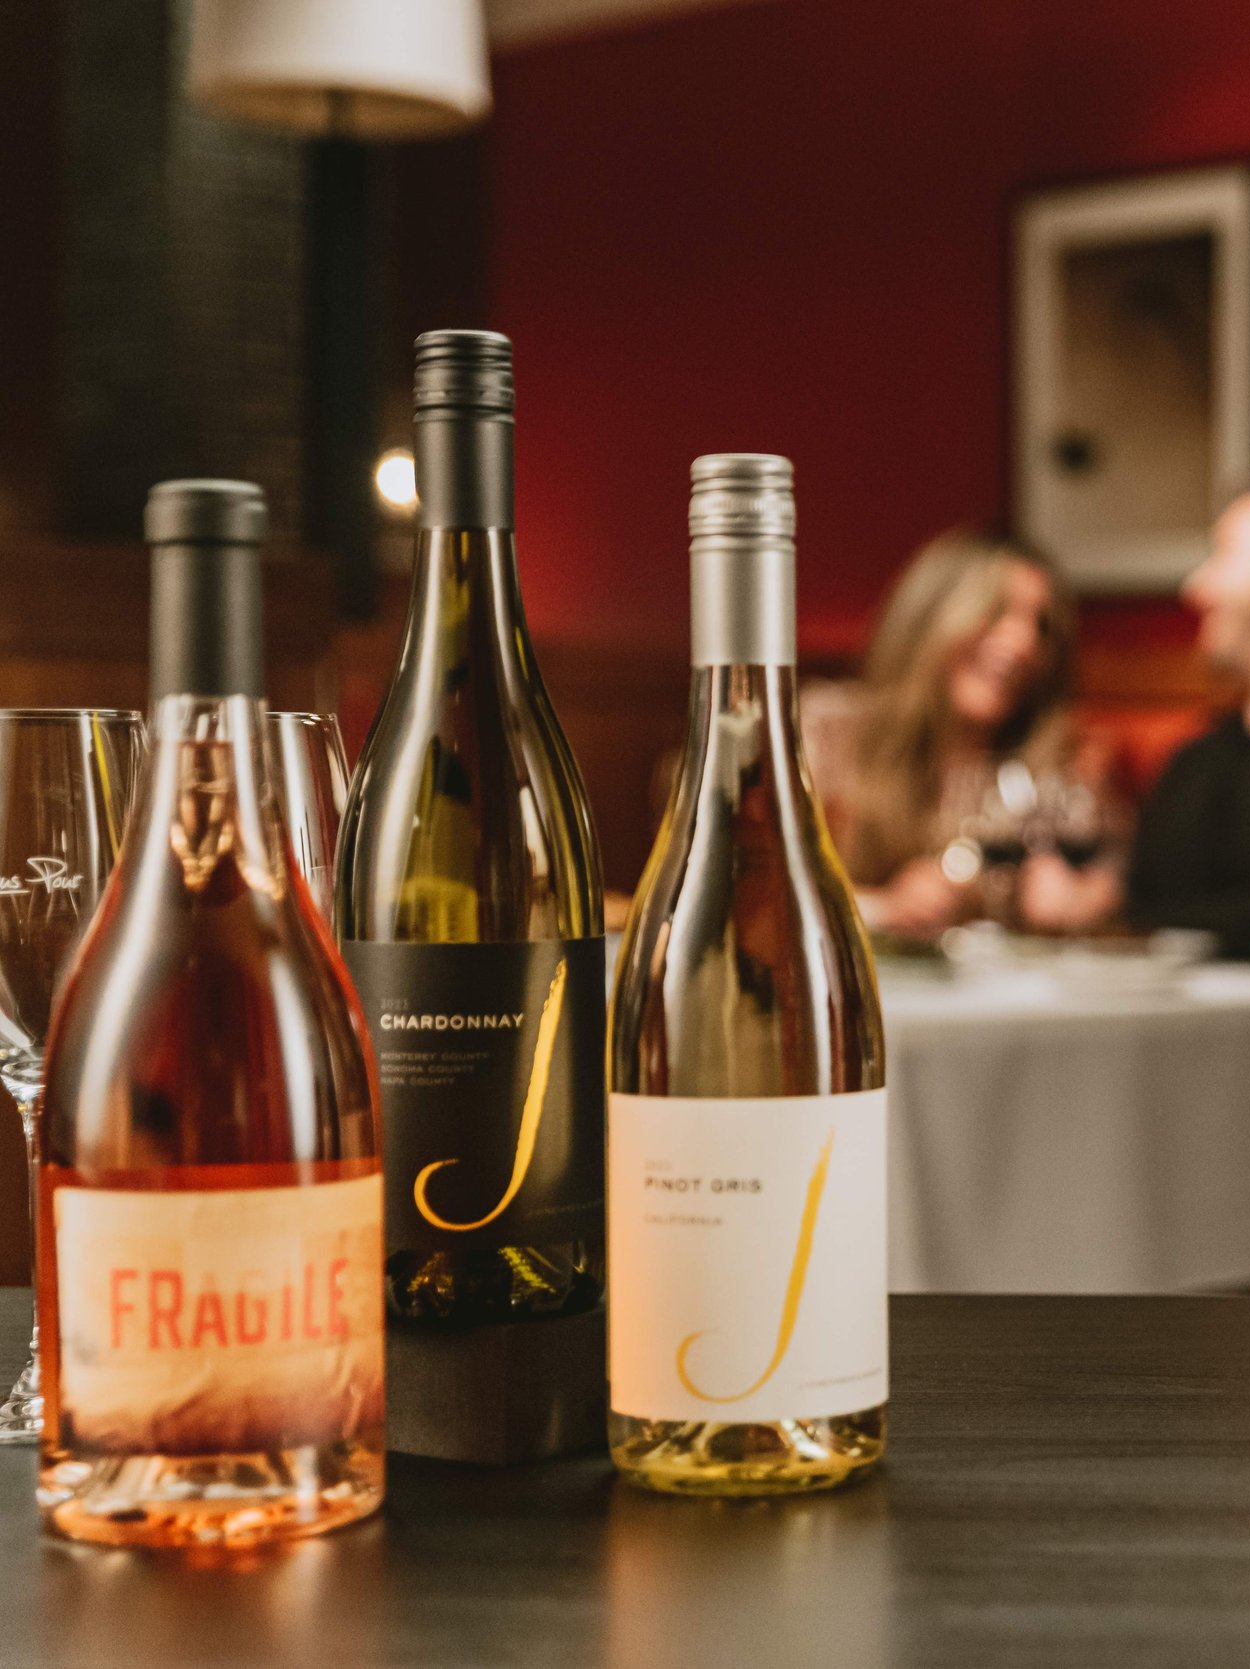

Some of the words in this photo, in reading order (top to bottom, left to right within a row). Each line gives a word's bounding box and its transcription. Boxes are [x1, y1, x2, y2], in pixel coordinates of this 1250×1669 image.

[25, 857, 84, 894] Pour
[379, 1013, 524, 1031] CHARDONNAY
[644, 1176, 702, 1193] PINOT
[710, 1178, 763, 1194] GRIS
[108, 1257, 351, 1350] FRAGILE
